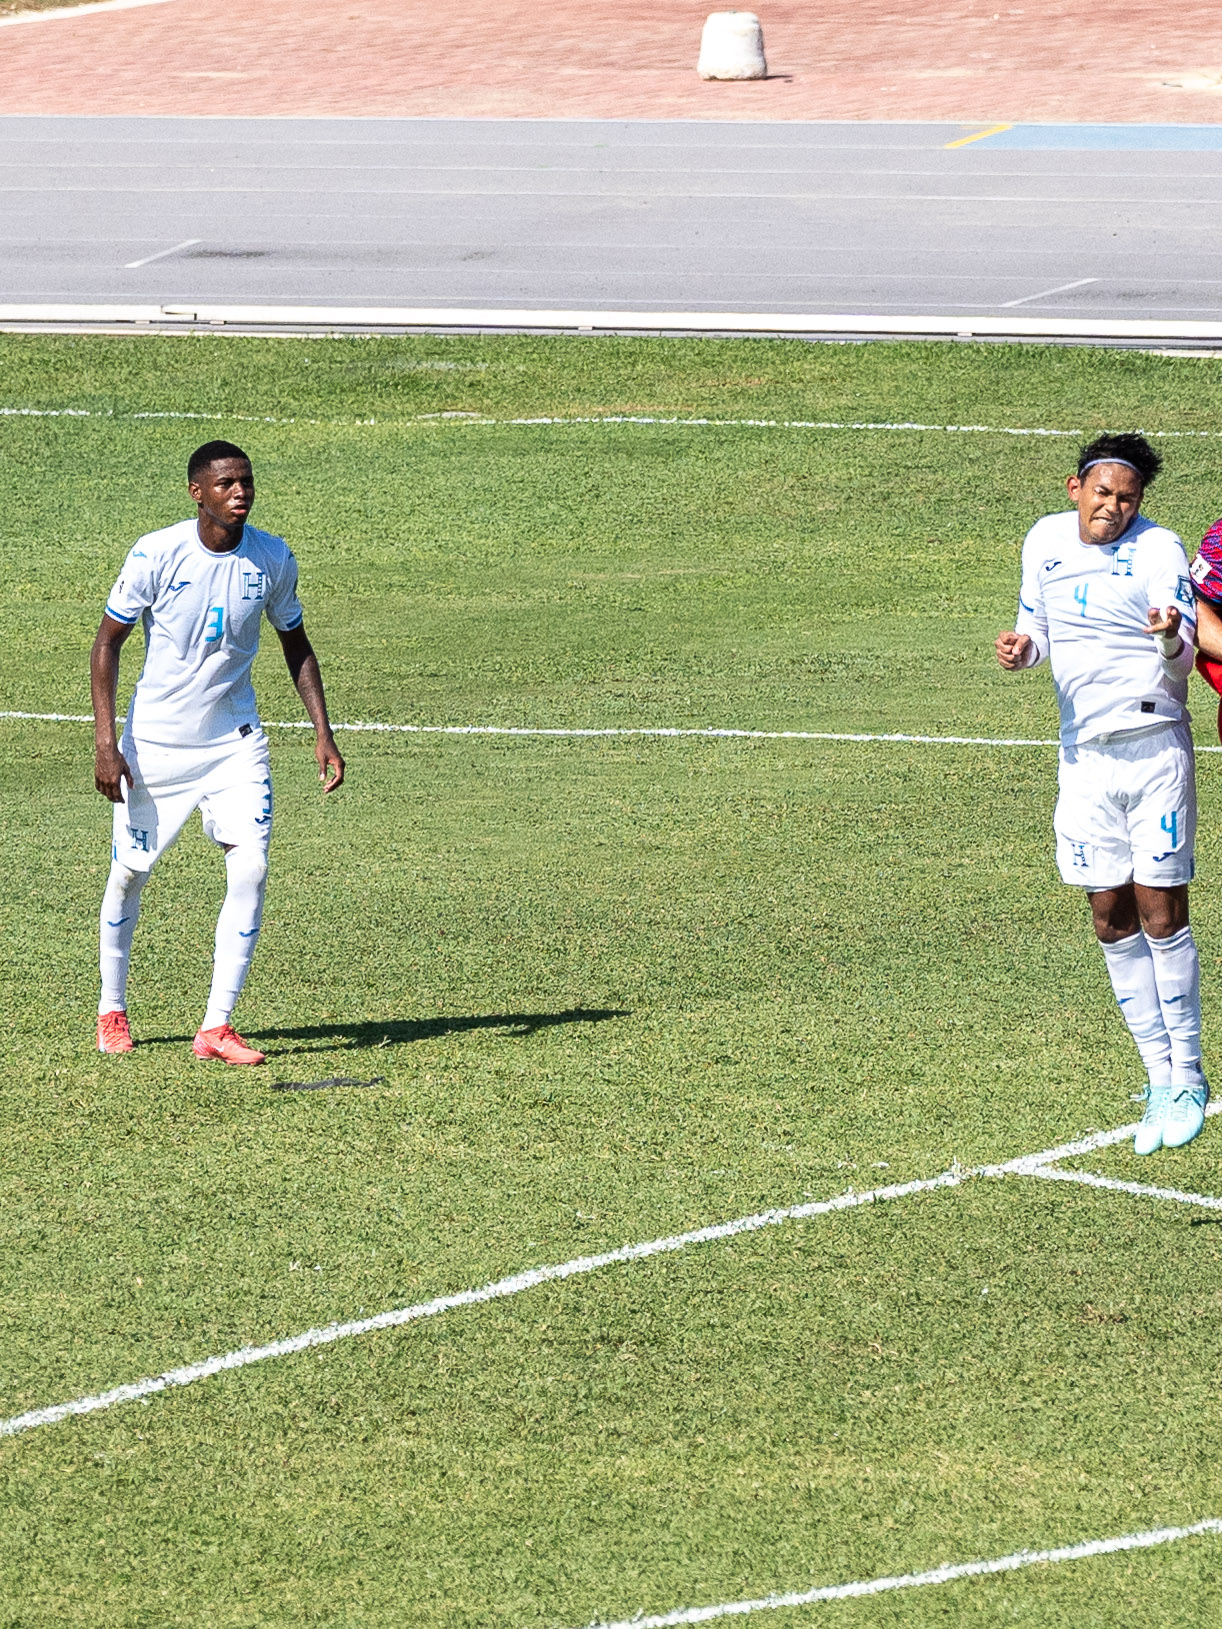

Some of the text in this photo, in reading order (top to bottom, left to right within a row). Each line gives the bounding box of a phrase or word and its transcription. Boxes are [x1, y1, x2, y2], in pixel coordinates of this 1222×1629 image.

[1111, 547, 1136, 576] H
[241, 572, 265, 600] H
[1074, 583, 1089, 617] 4
[205, 606, 225, 642] 3
[130, 828, 149, 853] H
[1160, 811, 1178, 849] 4
[1070, 843, 1089, 867] H
